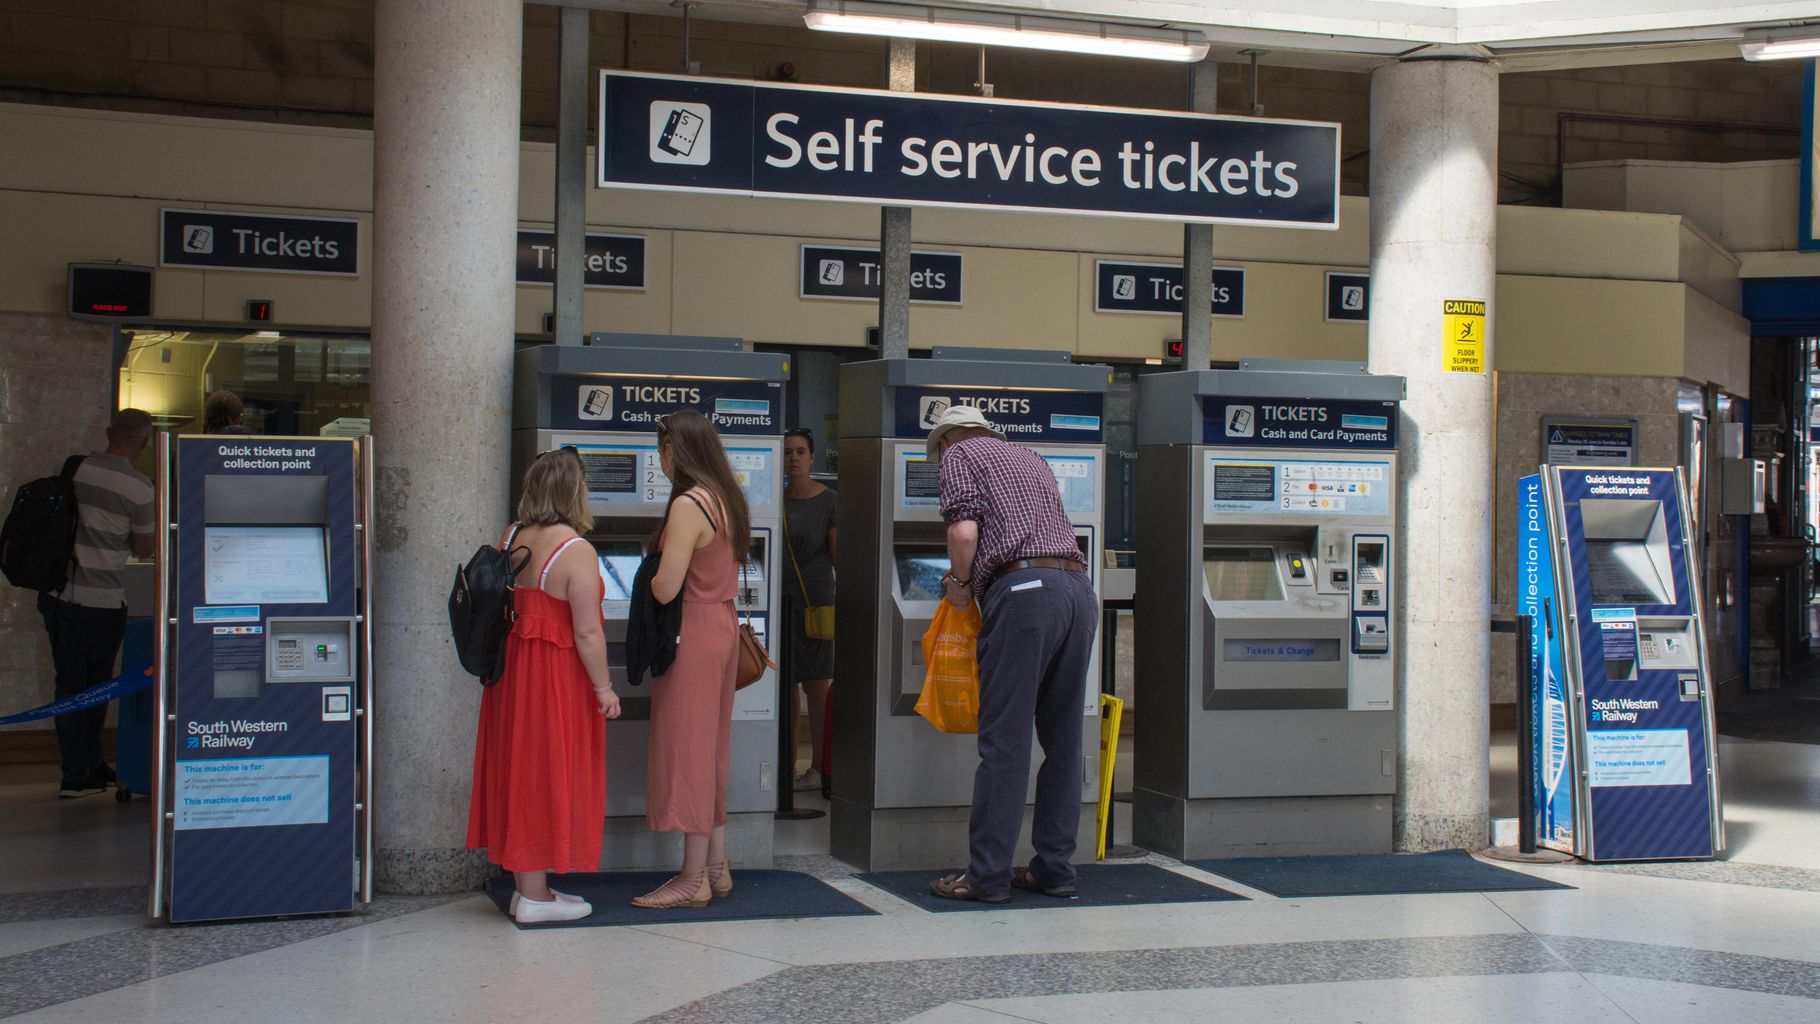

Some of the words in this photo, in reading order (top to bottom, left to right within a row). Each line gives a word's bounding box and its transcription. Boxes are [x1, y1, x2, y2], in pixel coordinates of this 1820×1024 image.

[764, 112, 883, 172] Self
[900, 132, 1101, 187] service
[1119, 141, 1298, 198] tickets
[232, 228, 339, 259] Tickets
[531, 245, 628, 273] Tiets
[859, 262, 946, 289] Tiets
[1149, 277, 1230, 303] Ticts
[1445, 302, 1485, 315] CAUTION
[1172, 342, 1183, 356] 4
[1453, 357, 1478, 365] SLIPPERY
[622, 386, 700, 404] TICKETS
[959, 397, 1031, 414] TICKETS
[621, 410, 651, 423] Cash
[712, 413, 772, 426] Payments
[1262, 405, 1327, 422] TICKETS
[988, 420, 1043, 434] Payments
[1261, 428, 1287, 440] Cash
[1289, 429, 1308, 440] and
[1310, 429, 1334, 441] Card
[1336, 430, 1387, 443] Payments
[218, 445, 251, 457] Quick
[253, 446, 292, 457] tickets
[295, 447, 316, 457] and
[223, 458, 279, 469] collection
[281, 459, 311, 471] point
[648, 455, 654, 466] 1
[647, 472, 654, 483] 2
[1284, 467, 1290, 477] 1
[1283, 482, 1290, 492] 2
[1585, 475, 1608, 486] Quick
[1609, 475, 1633, 485] tickets
[1635, 476, 1651, 485] and
[647, 489, 655, 500] 3
[1590, 485, 1628, 495] collection
[1628, 486, 1649, 496] point
[1283, 498, 1290, 508] 3
[1526, 484, 1540, 531] point
[1246, 646, 1275, 656] Tickets
[1278, 647, 1284, 656] &
[1286, 646, 1315, 657] Change
[75, 681, 119, 702] Queue
[79, 693, 111, 705] Way
[1592, 699, 1619, 710] South
[1620, 698, 1658, 710] Western
[1602, 710, 1637, 723] Railway
[187, 721, 229, 734] South
[231, 720, 288, 733] Western
[202, 735, 255, 749] Railway
[184, 765, 202, 773] This
[203, 764, 239, 772] machine
[250, 763, 265, 771] for:
[184, 797, 202, 806] This
[203, 796, 239, 805] machine
[240, 795, 260, 803] does
